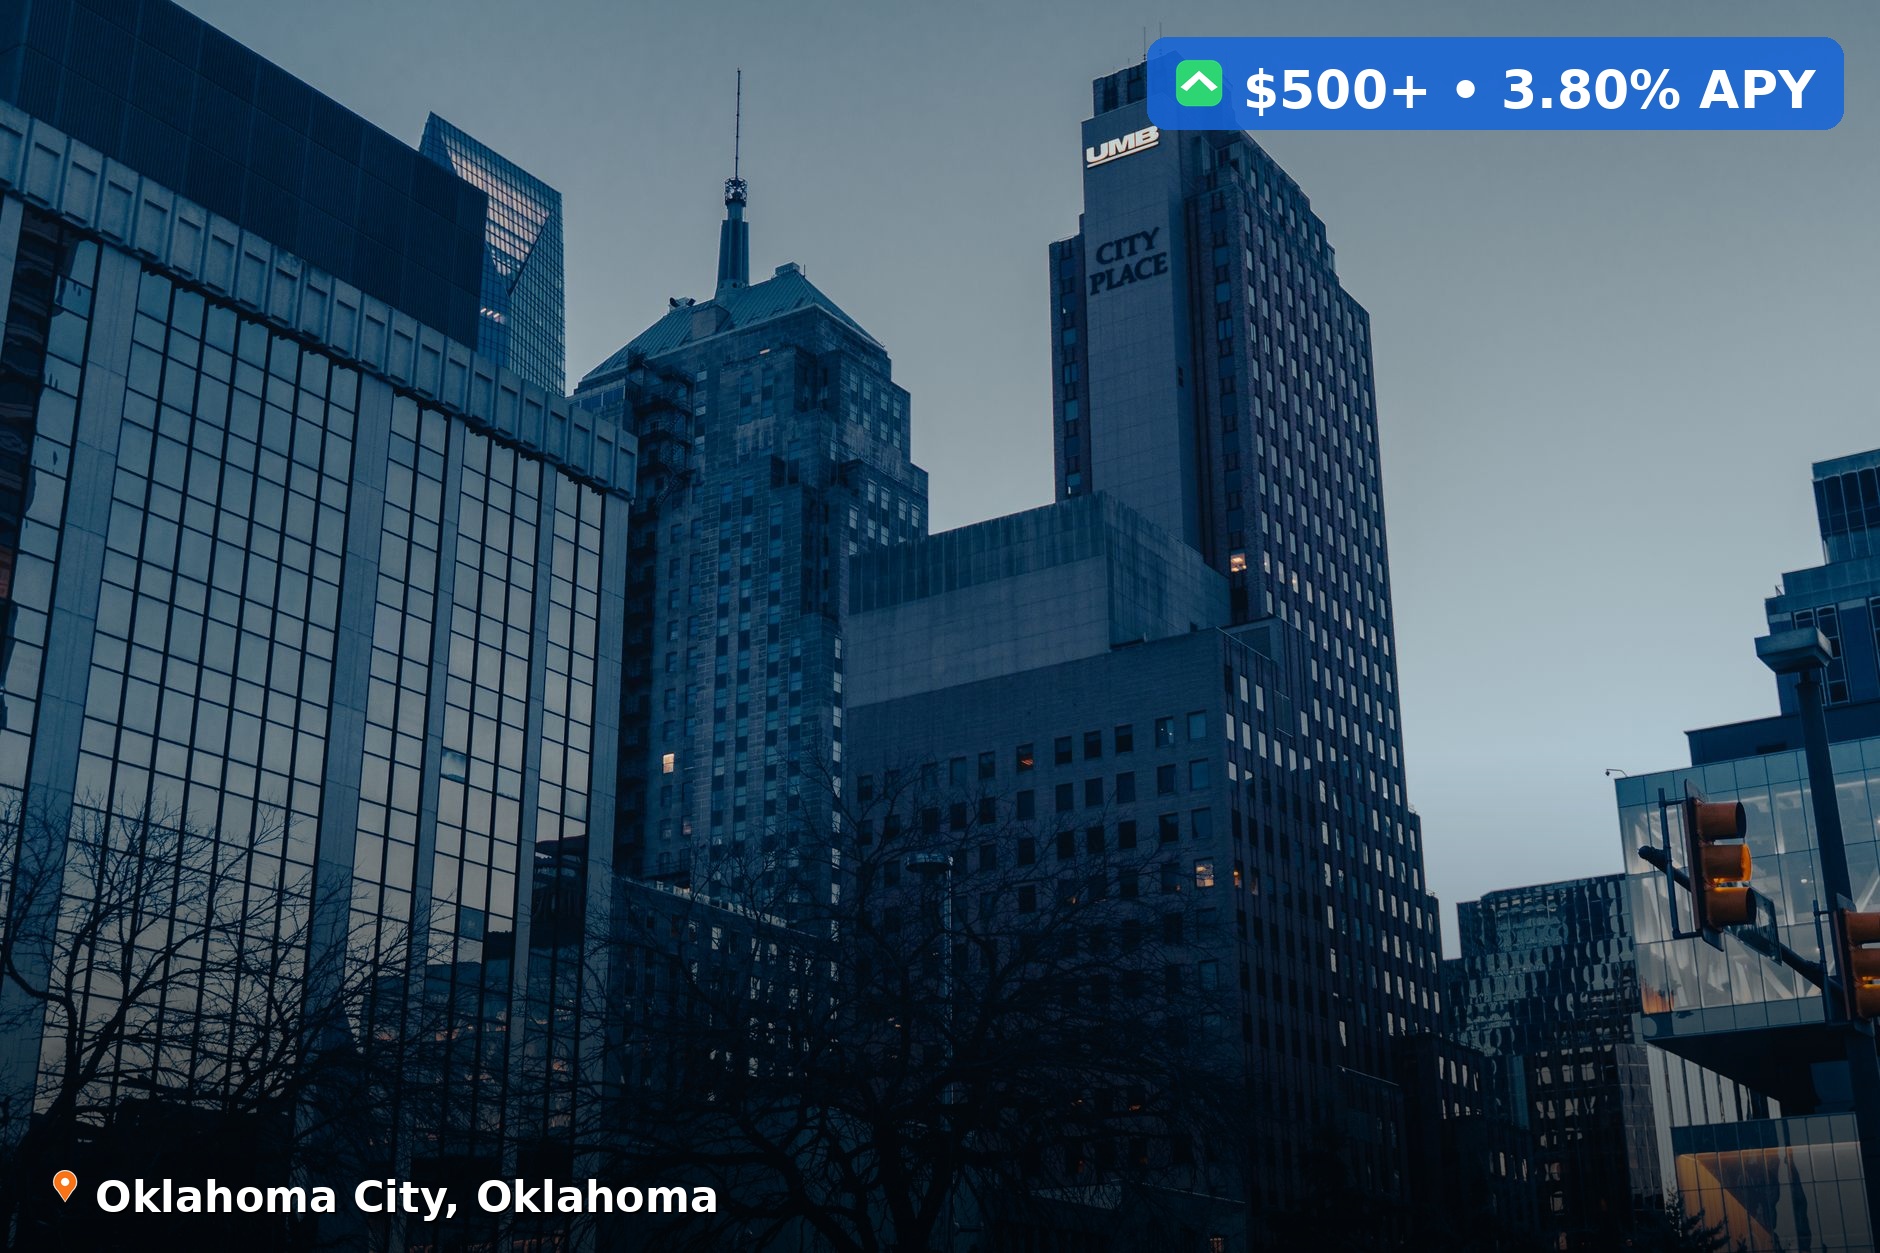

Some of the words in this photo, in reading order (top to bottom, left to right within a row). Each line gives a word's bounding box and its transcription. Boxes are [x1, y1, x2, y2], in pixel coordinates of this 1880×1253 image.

[1086, 125, 1160, 166] UMB
[1096, 226, 1160, 265] CITY
[1089, 252, 1169, 296] PLACE
